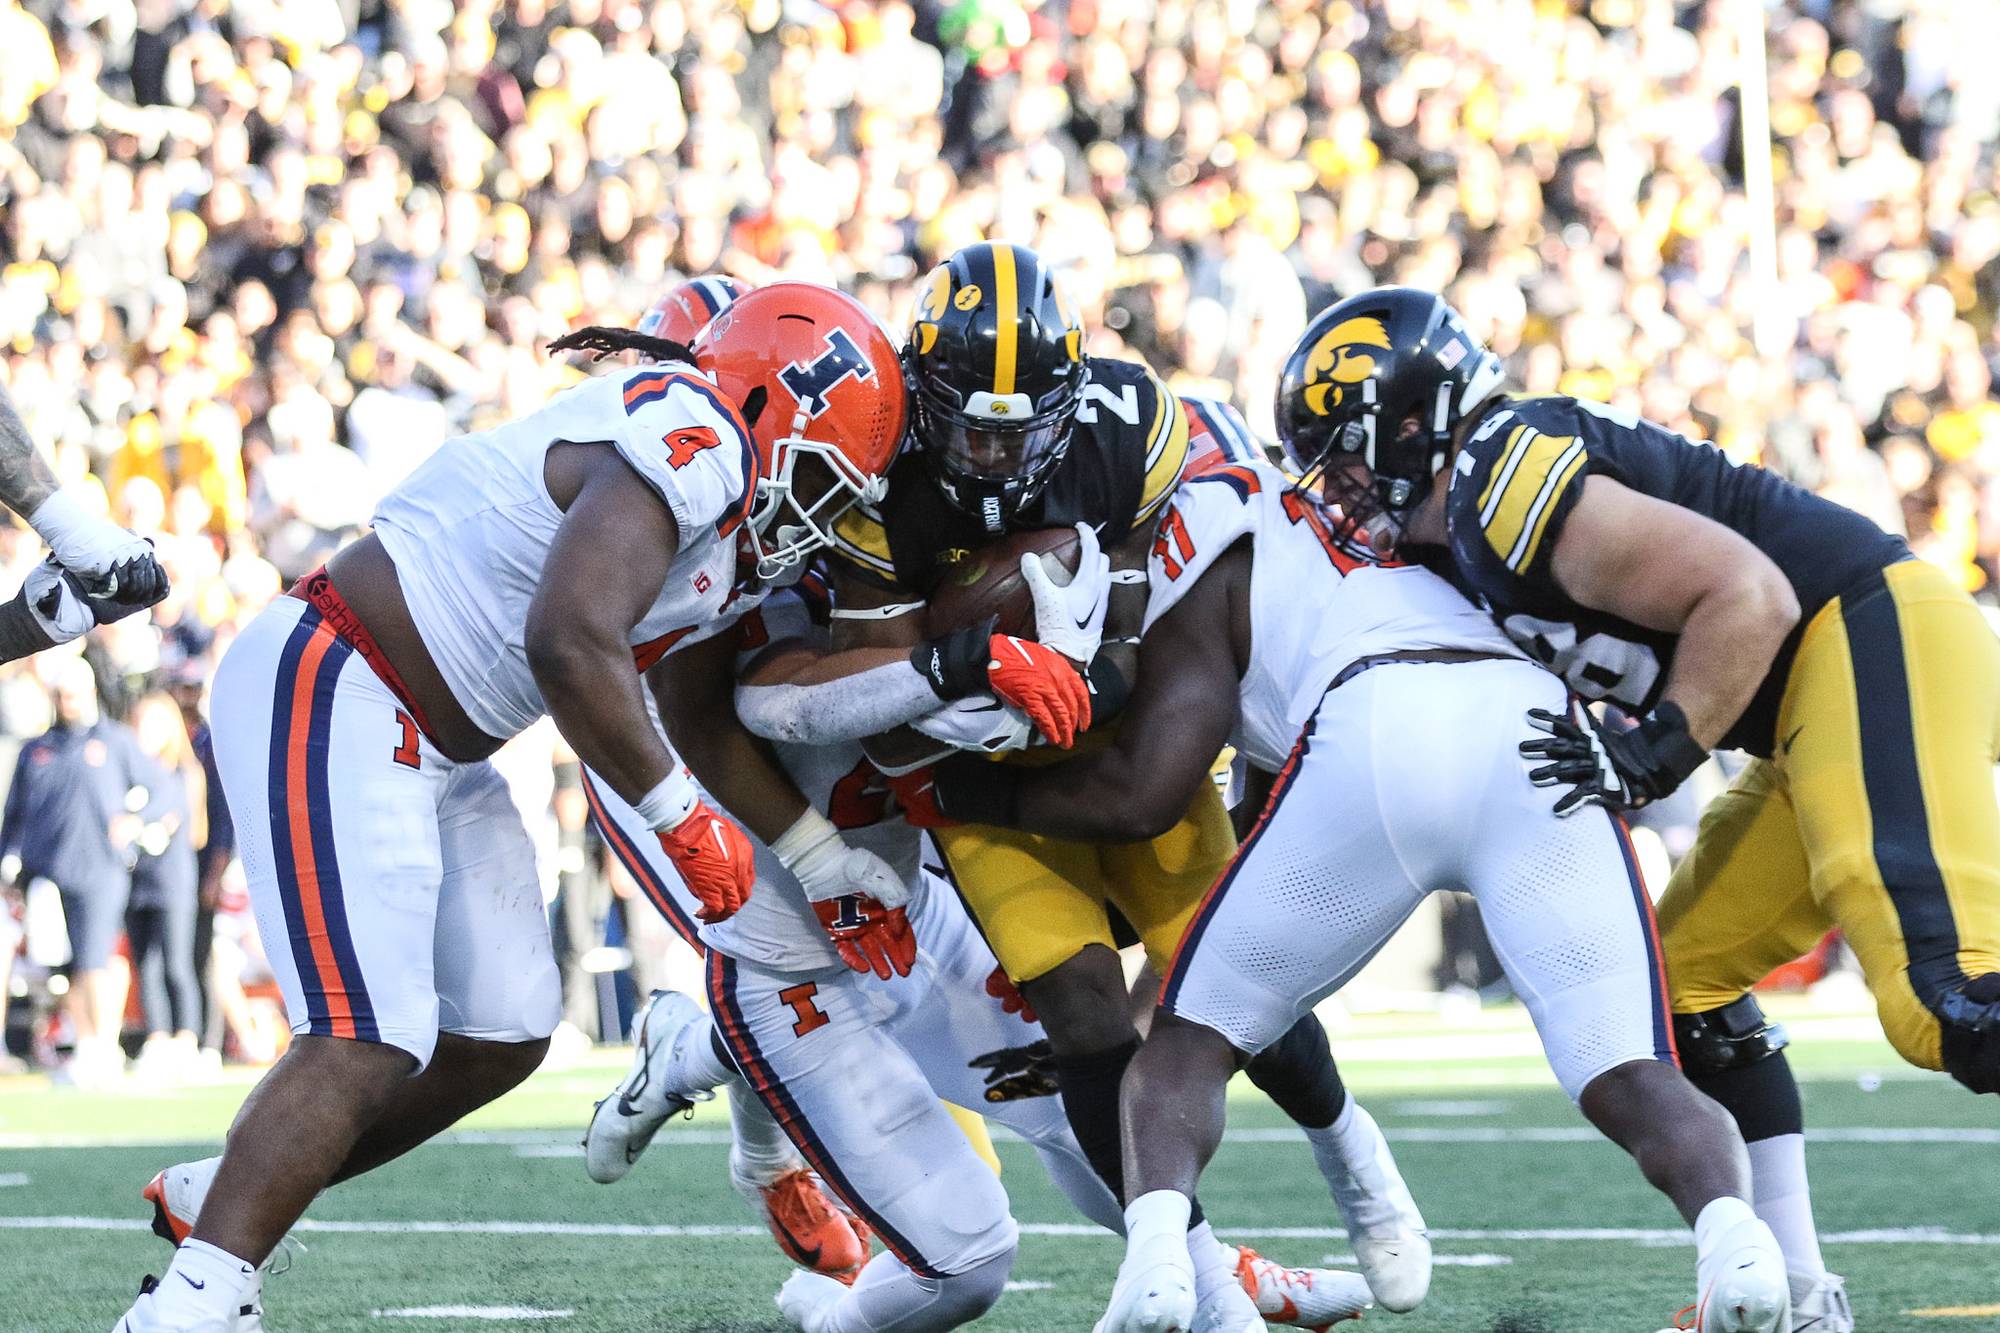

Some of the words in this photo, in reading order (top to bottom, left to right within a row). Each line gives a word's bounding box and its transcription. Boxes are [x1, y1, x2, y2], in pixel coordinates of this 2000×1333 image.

[1074, 383, 1140, 425] 2
[662, 426, 721, 472] 4
[1152, 503, 1197, 582] 17
[318, 592, 373, 658] ethika
[778, 981, 830, 1038] I
